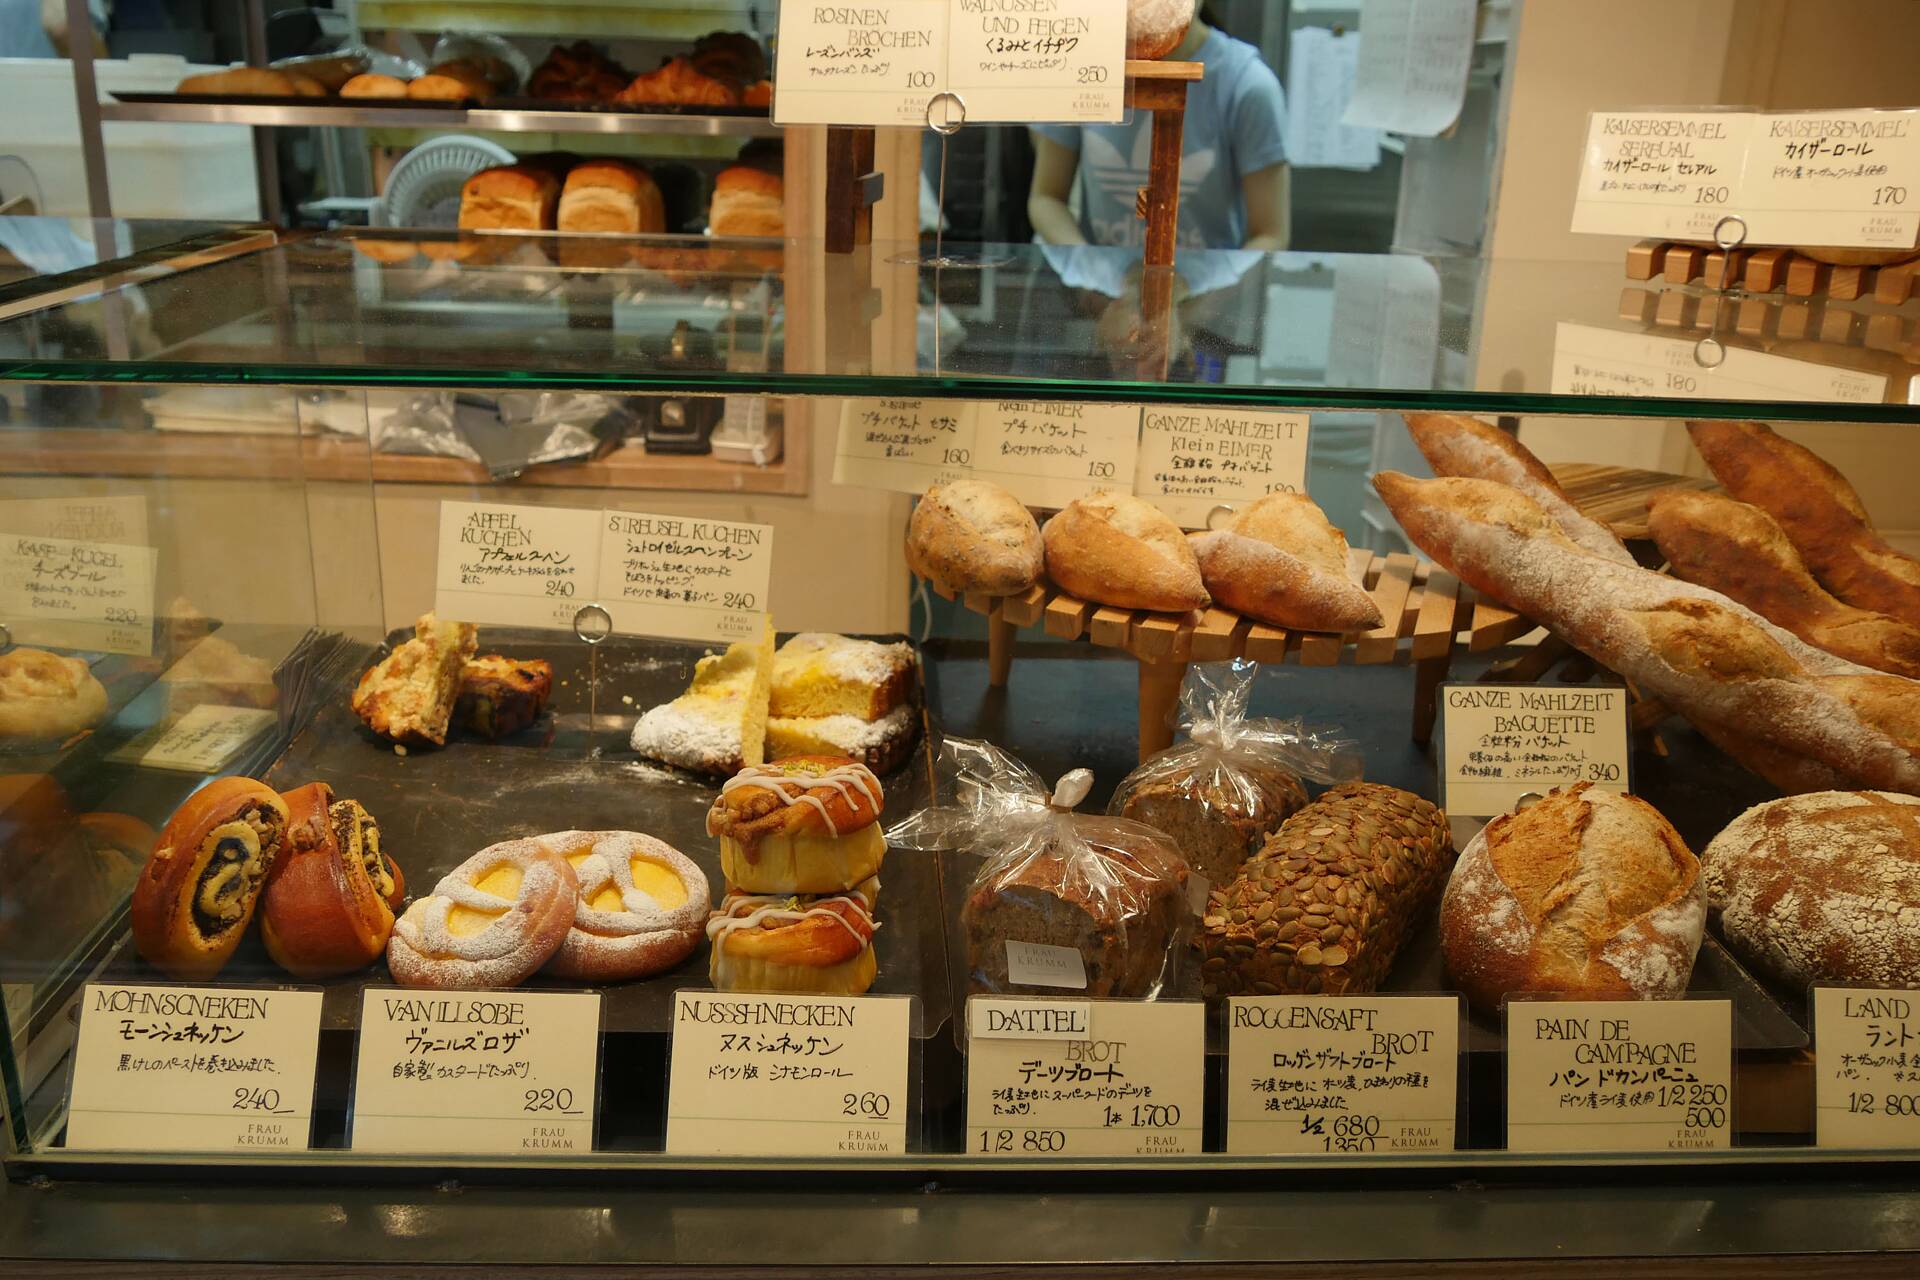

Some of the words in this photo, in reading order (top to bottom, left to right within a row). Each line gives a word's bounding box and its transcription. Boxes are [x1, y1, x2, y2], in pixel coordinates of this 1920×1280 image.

[814, 7, 889, 25] ROSINEN
[982, 17, 1019, 33] UND
[1028, 17, 1090, 35] FEIGEN
[906, 71, 936, 88] 100
[1077, 66, 1108, 83] 250
[1603, 118, 1726, 139] KAISERSEMMEL
[1769, 119, 1909, 138] KAISERSEMMEL
[1785, 138, 1874, 159] カイザーロール
[1603, 157, 1670, 173] カイザーロール
[1694, 187, 1729, 203] 180
[1872, 186, 1907, 205] 170
[1146, 413, 1201, 434] GANZE
[1204, 416, 1298, 440] MAHLZEIT
[942, 448, 970, 464] 160
[1171, 436, 1214, 452] Klein
[1218, 440, 1273, 461] EIMER
[1088, 461, 1116, 478] 150
[468, 512, 521, 529] APFEL
[460, 527, 532, 547] KUCHEN
[692, 523, 762, 545] KUCHEN
[545, 580, 575, 597] 240
[723, 592, 755, 609] 240
[104, 607, 137, 623] 220
[1450, 691, 1512, 709] GANZE
[1520, 692, 1614, 712] MAHLZEIT
[1494, 715, 1596, 734] BAGUETTE
[1589, 764, 1620, 781] 340
[384, 999, 523, 1025] VANILLSOBE
[1234, 1006, 1378, 1031] ROGGENSAFT
[1844, 998, 1911, 1020] LAND
[987, 1009, 1087, 1033] DATTEL
[1535, 1019, 1589, 1040] PAIN
[1600, 1020, 1630, 1041] DE
[119, 1020, 244, 1044] モーンシュネッケン
[405, 1027, 530, 1054] ヴァニルズロザ
[720, 1033, 844, 1056] ヌスシュネッケン
[1065, 1040, 1127, 1064] BROT
[1370, 1031, 1434, 1055] BROT
[1273, 1048, 1396, 1071] ロッゲンザフトブロート
[1575, 1042, 1697, 1065] CAMPAGNE
[769, 1063, 854, 1081] シナモンロール
[1019, 1061, 1124, 1084] デーツブロート
[233, 1088, 280, 1110] 240
[524, 1088, 573, 1112] 220
[843, 1092, 890, 1117] 260
[1657, 1085, 1686, 1107] 1/2
[1690, 1085, 1728, 1106] 250
[1848, 1092, 1875, 1114] 1/2
[1130, 1104, 1181, 1128] 1,700
[1333, 1115, 1380, 1137] 680
[1685, 1107, 1726, 1128] 500
[248, 1124, 282, 1134] FRAU
[532, 1128, 566, 1138] FRAU
[848, 1131, 880, 1141] FRAU
[1400, 1127, 1431, 1137] FRAU
[1677, 1130, 1707, 1139] FRAU
[237, 1135, 289, 1146] KRUMM
[522, 1138, 574, 1149] KRUMM
[838, 1142, 889, 1151] KRUMM
[979, 1130, 1014, 1153] 1/2
[1022, 1130, 1066, 1152] 850
[1146, 1136, 1177, 1146] FRAU
[1391, 1138, 1439, 1147] KRUMM
[1668, 1140, 1715, 1148] KRUMM
